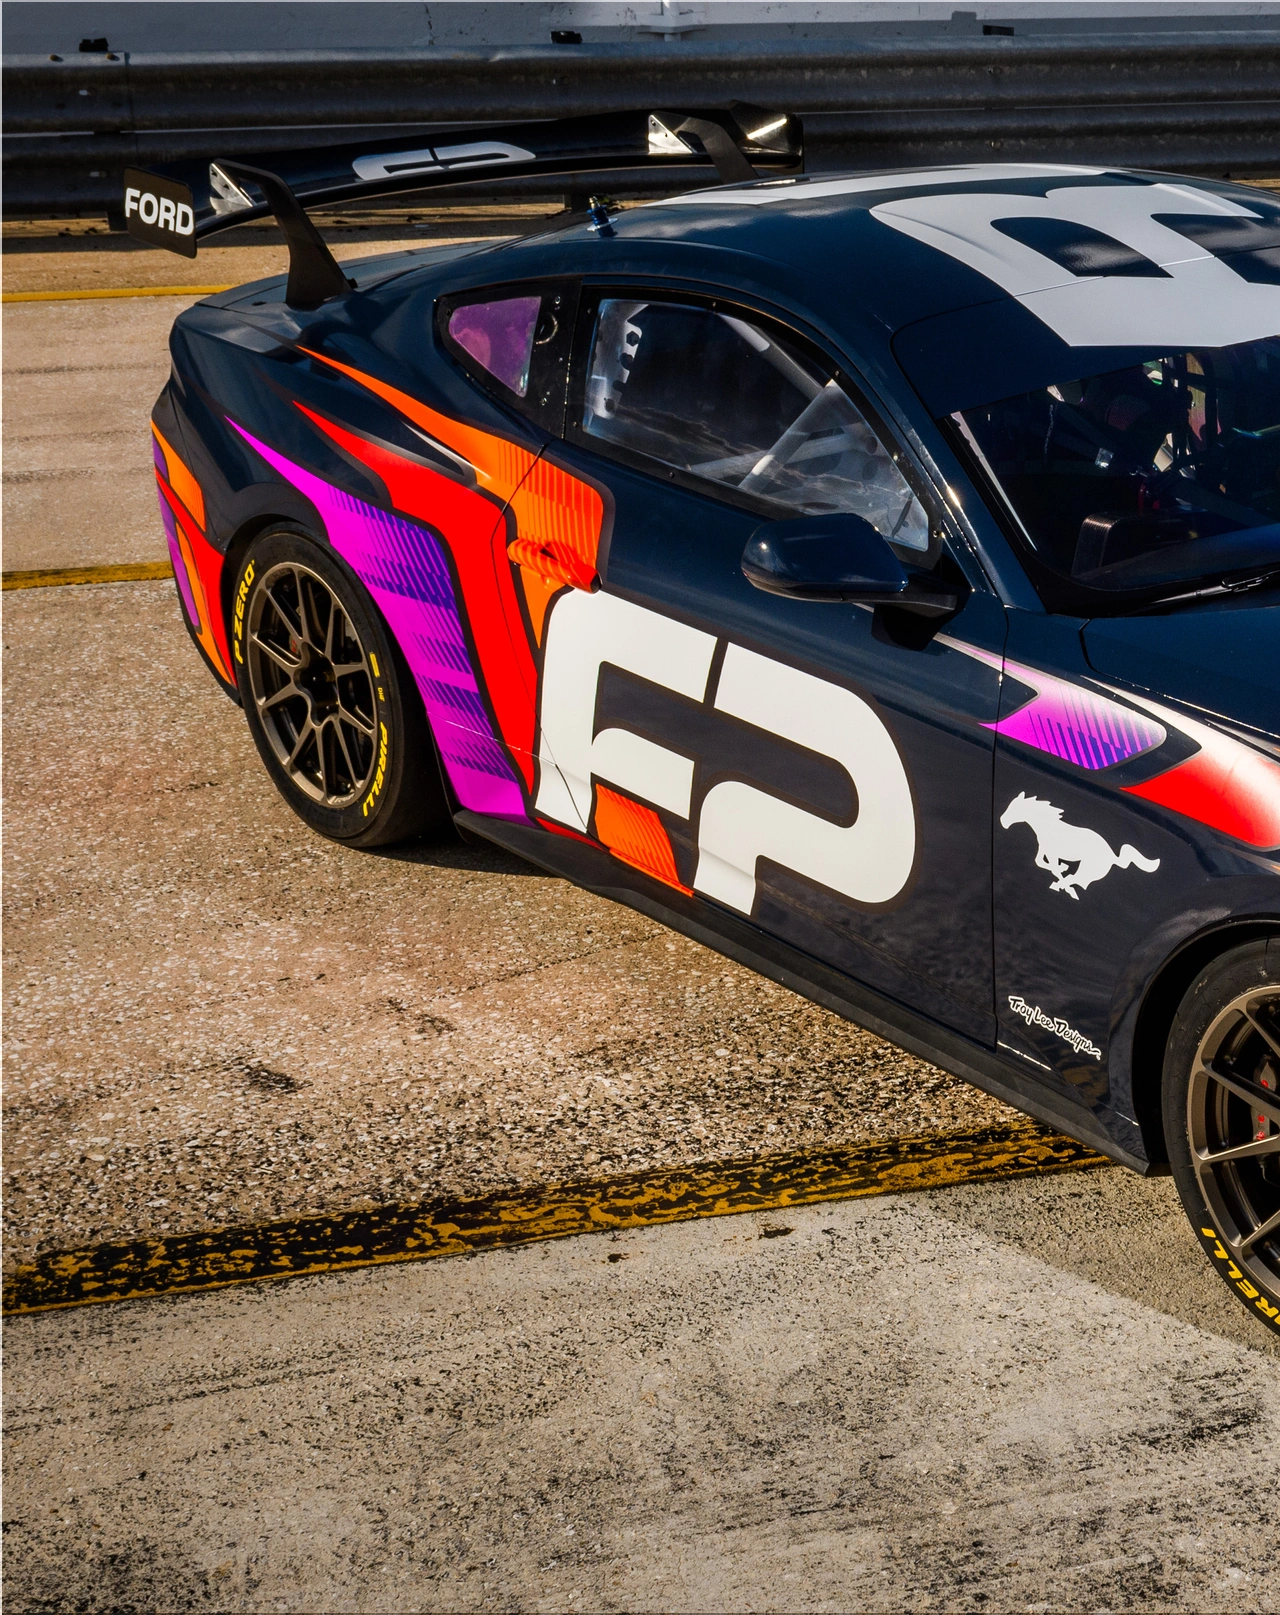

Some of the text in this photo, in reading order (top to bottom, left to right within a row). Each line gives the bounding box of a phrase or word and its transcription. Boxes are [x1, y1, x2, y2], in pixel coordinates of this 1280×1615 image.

[125, 187, 194, 236] FORD
[234, 639, 243, 665] P
[362, 721, 388, 817] PIRELLI
[534, 585, 916, 916] FP
[1008, 995, 1102, 1061] Troy Lee Designs
